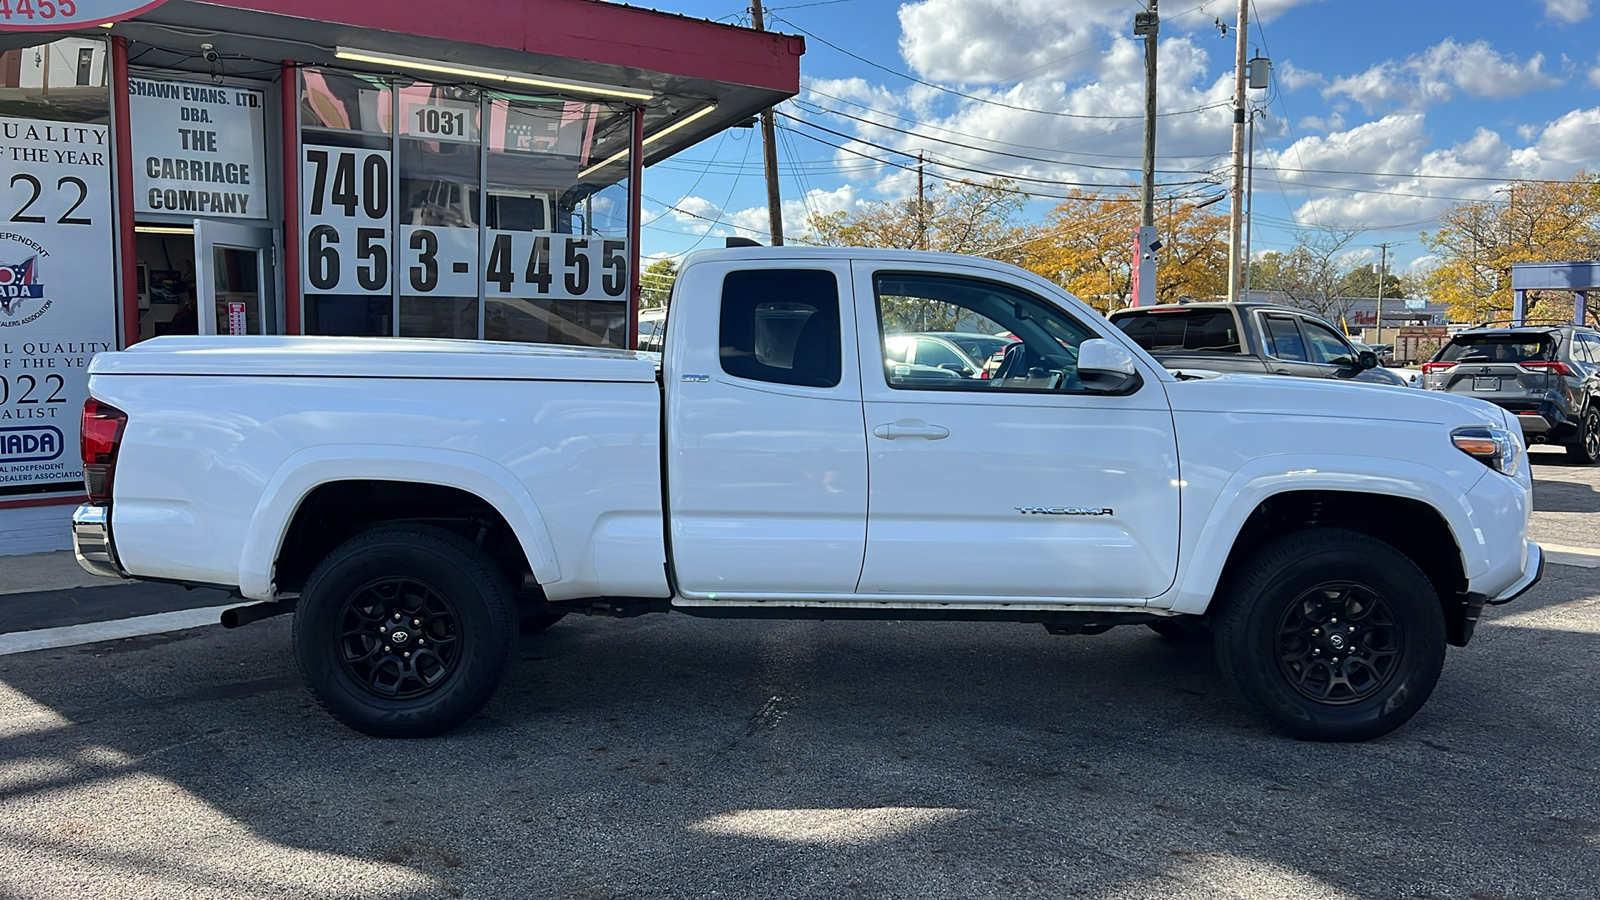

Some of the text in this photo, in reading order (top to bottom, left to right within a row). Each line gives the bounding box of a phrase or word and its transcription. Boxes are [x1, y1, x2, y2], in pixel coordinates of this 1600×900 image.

[129, 79, 180, 100] SHAWN
[235, 92, 262, 109] LTD.
[180, 106, 213, 124] DBA.
[415, 108, 465, 137] 1031
[178, 128, 217, 153] THE
[8, 146, 49, 163] THE
[54, 149, 105, 167] YEAR
[146, 156, 250, 186] CARRIAGE
[306, 149, 389, 220] 740
[147, 187, 250, 214] COMPANY
[21, 299, 53, 325] ASSOCIATION
[23, 342, 111, 356] QUALITY
[20, 358, 56, 369] THE
[64, 357, 91, 368] YE
[10, 462, 65, 473] INDEPENDENT
